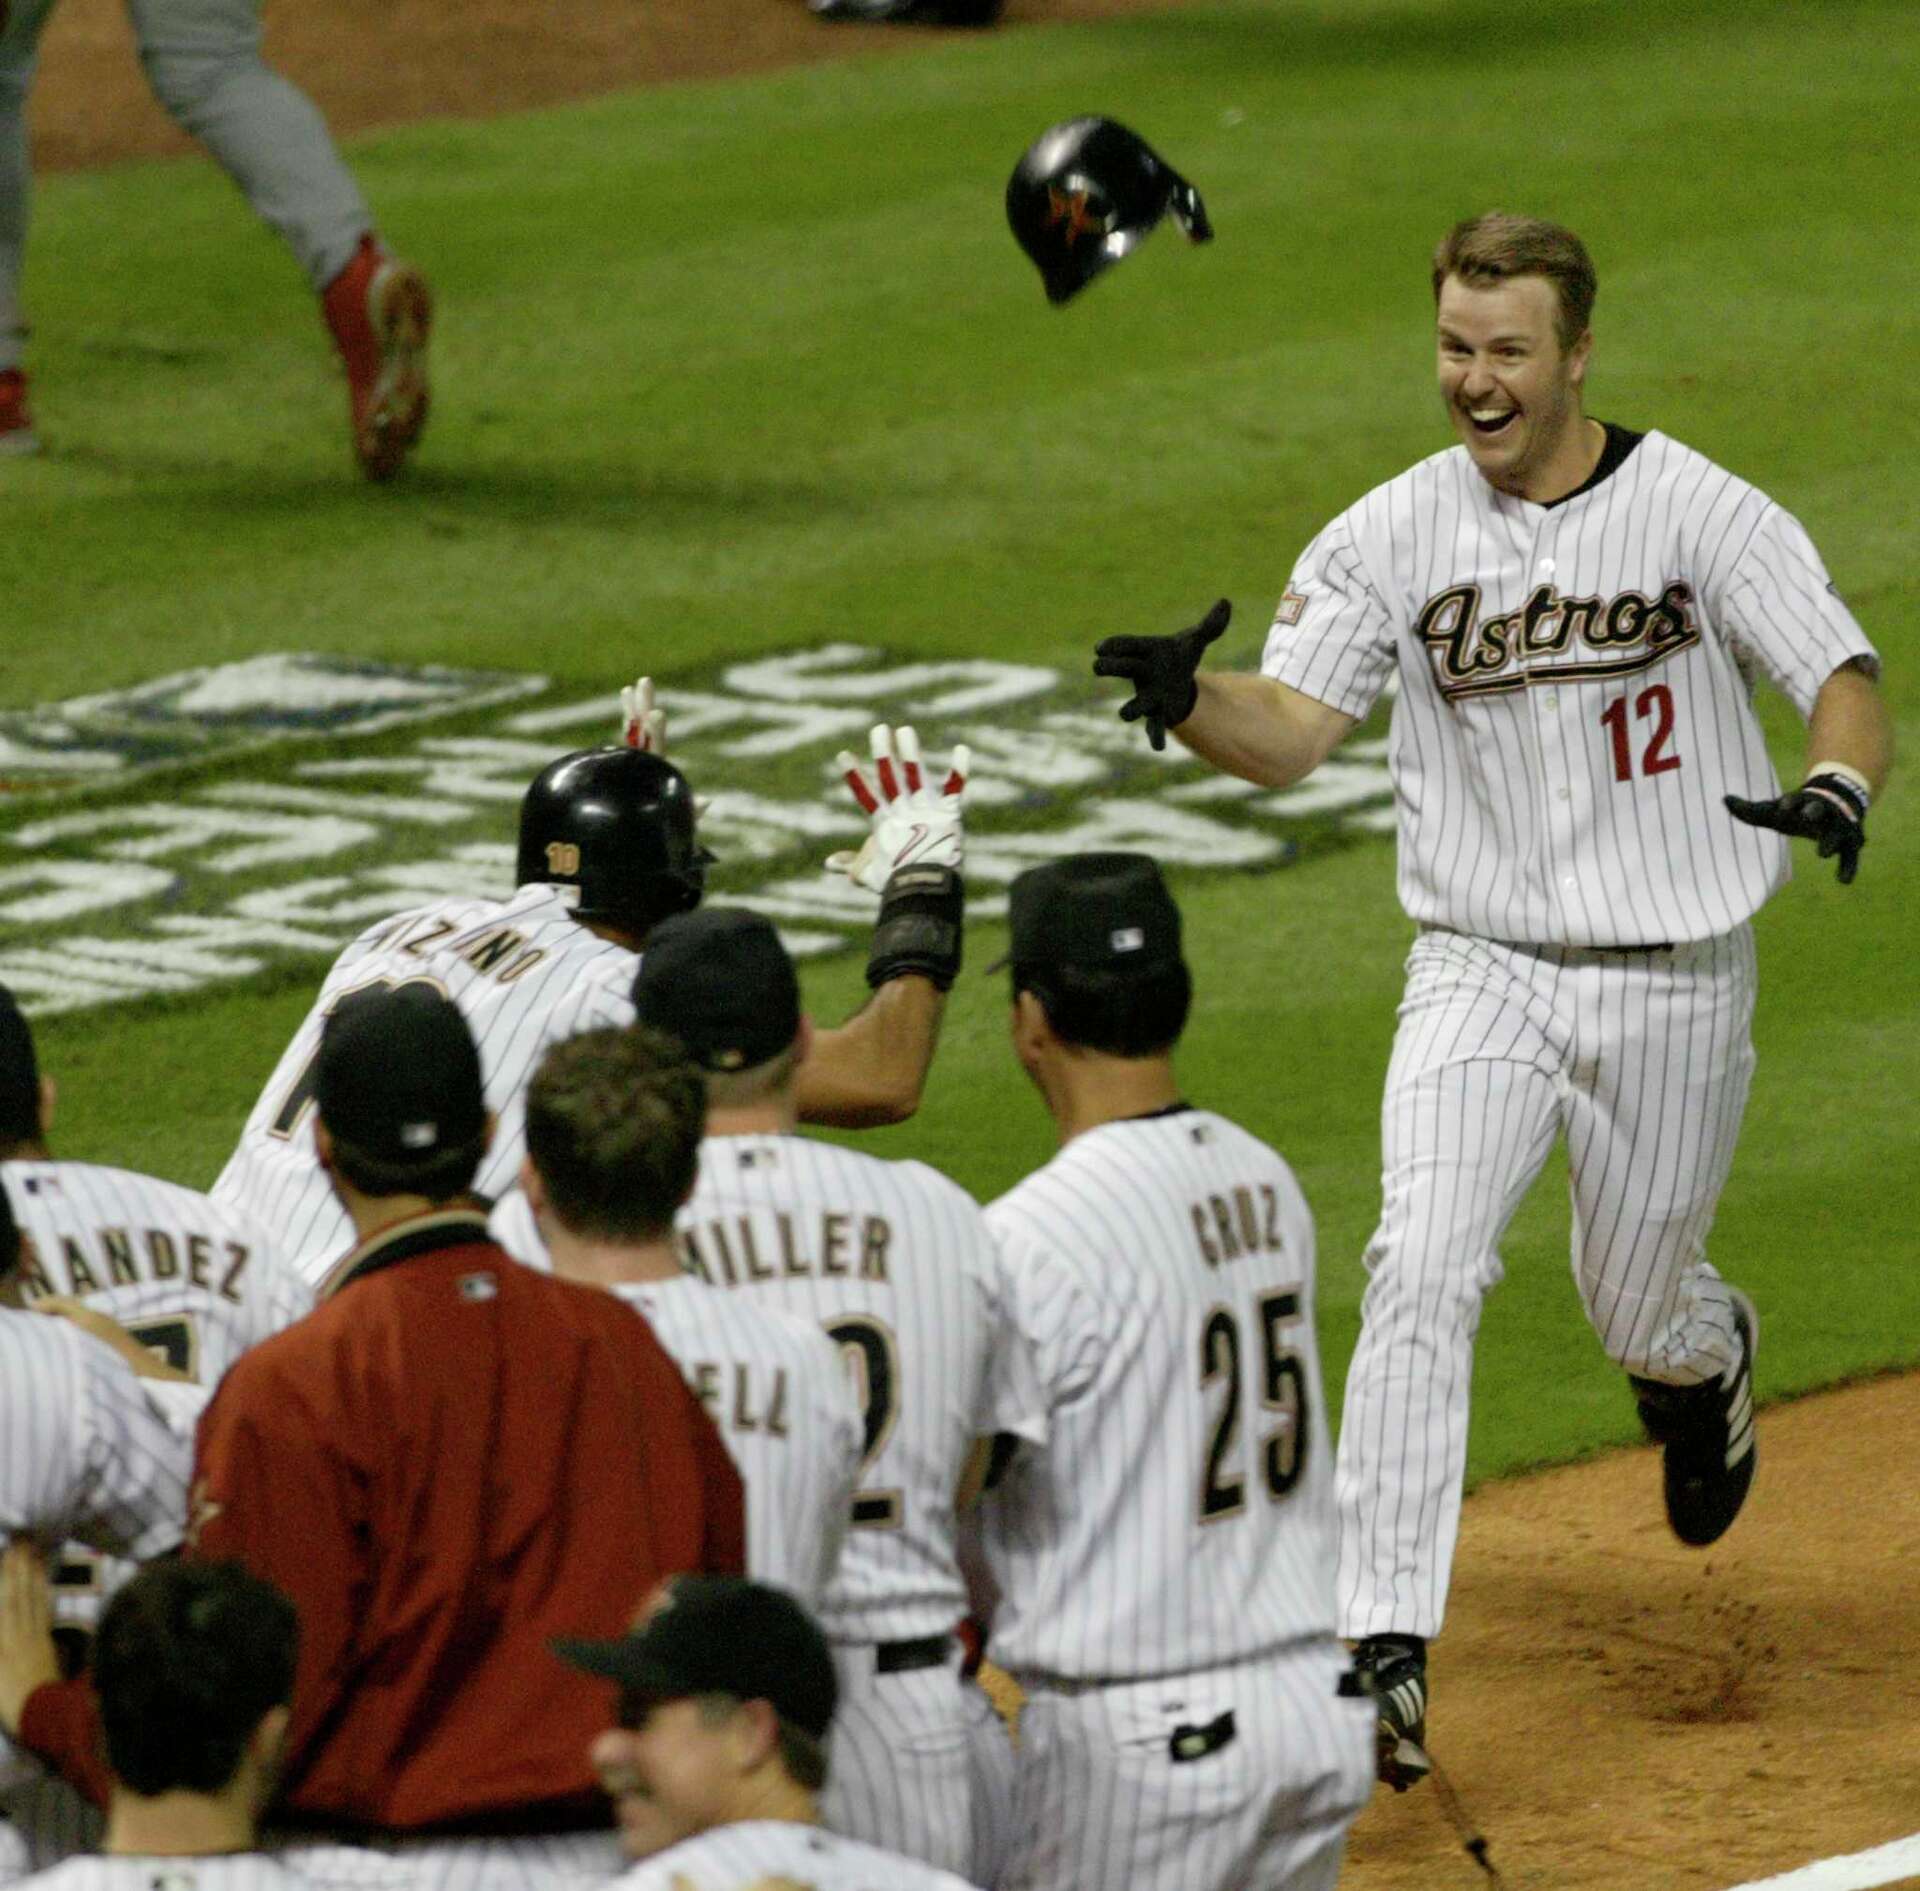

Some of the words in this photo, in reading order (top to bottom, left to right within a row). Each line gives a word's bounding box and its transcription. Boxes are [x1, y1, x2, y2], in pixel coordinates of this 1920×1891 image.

[1416, 578, 1699, 699] Astros
[1600, 683, 1682, 783] 12
[1190, 1183, 1283, 1271] CRUZ
[1197, 1281, 1309, 1526] 25
